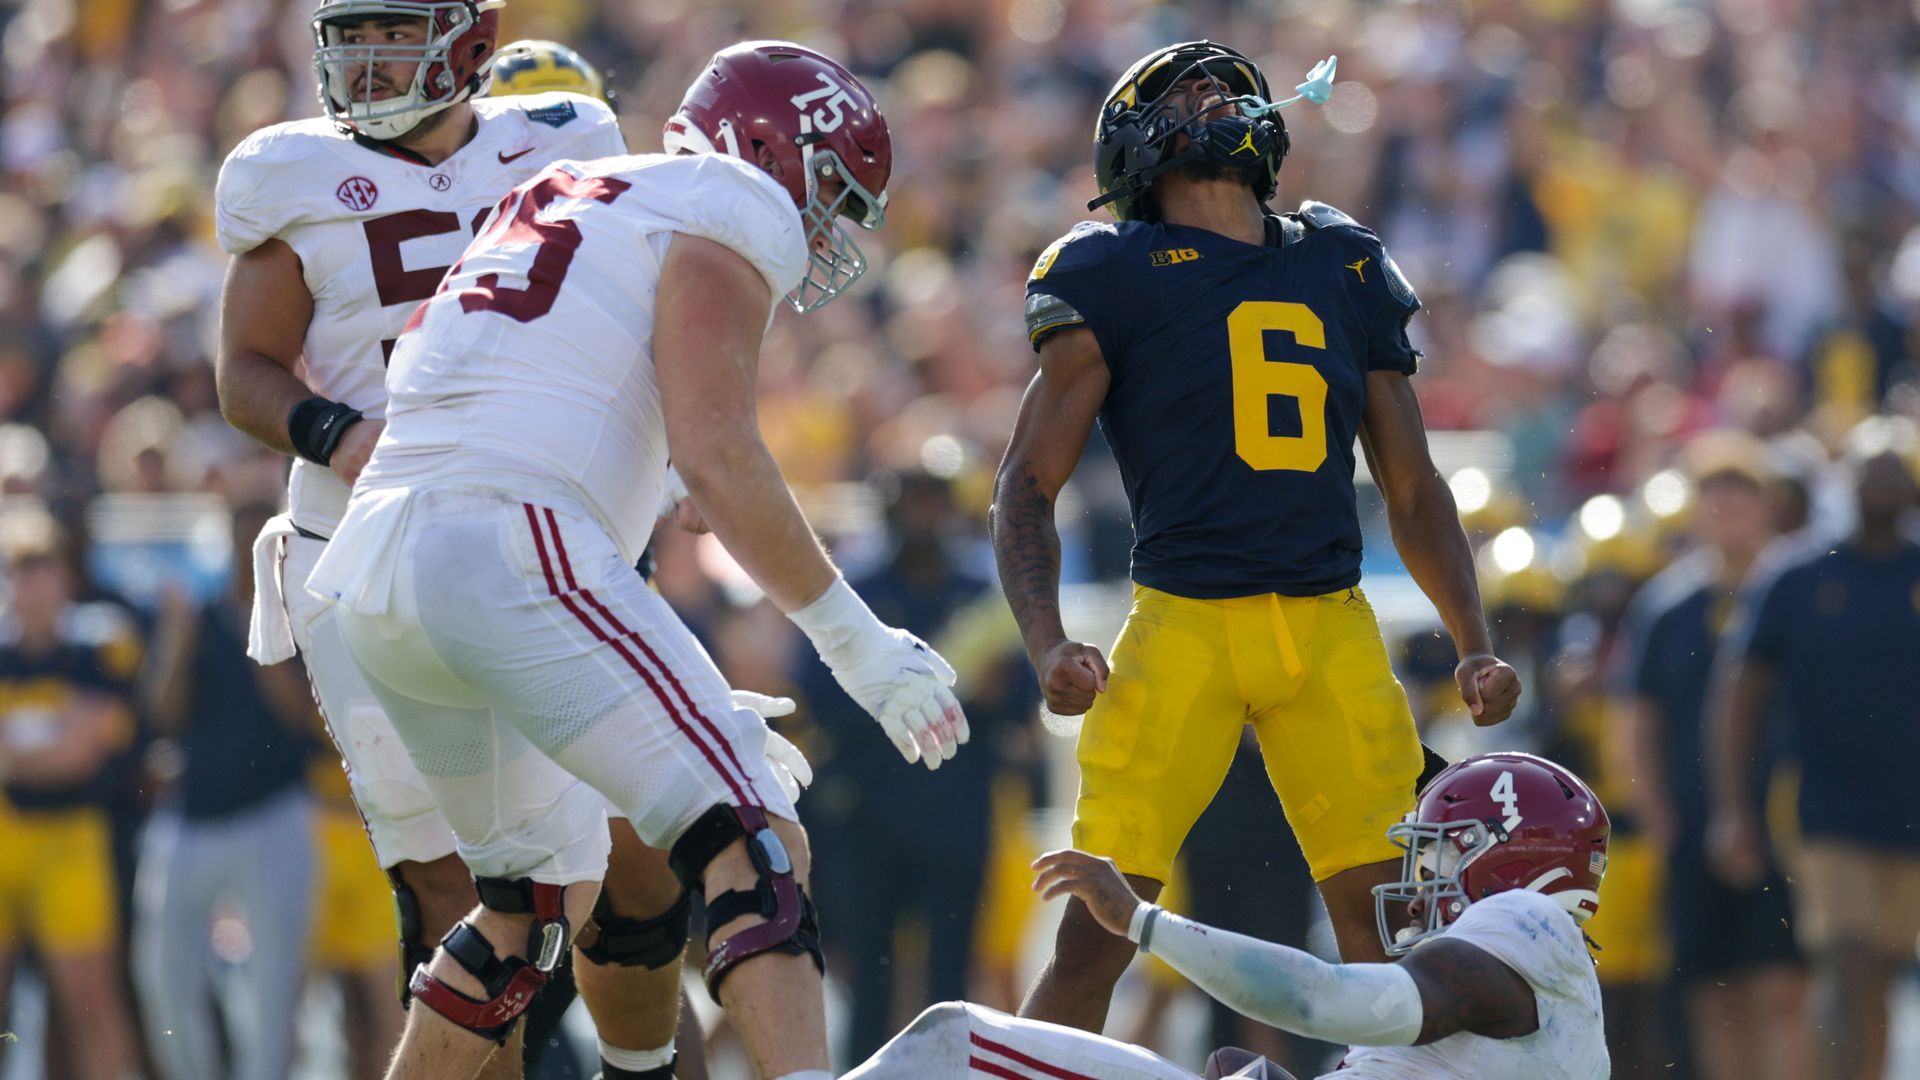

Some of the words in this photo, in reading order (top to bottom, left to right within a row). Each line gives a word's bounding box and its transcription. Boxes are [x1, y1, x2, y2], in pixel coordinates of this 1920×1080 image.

[790, 72, 859, 133] 75
[337, 177, 377, 211] SEC
[1228, 301, 1328, 471] 6
[1489, 771, 1519, 816] 4
